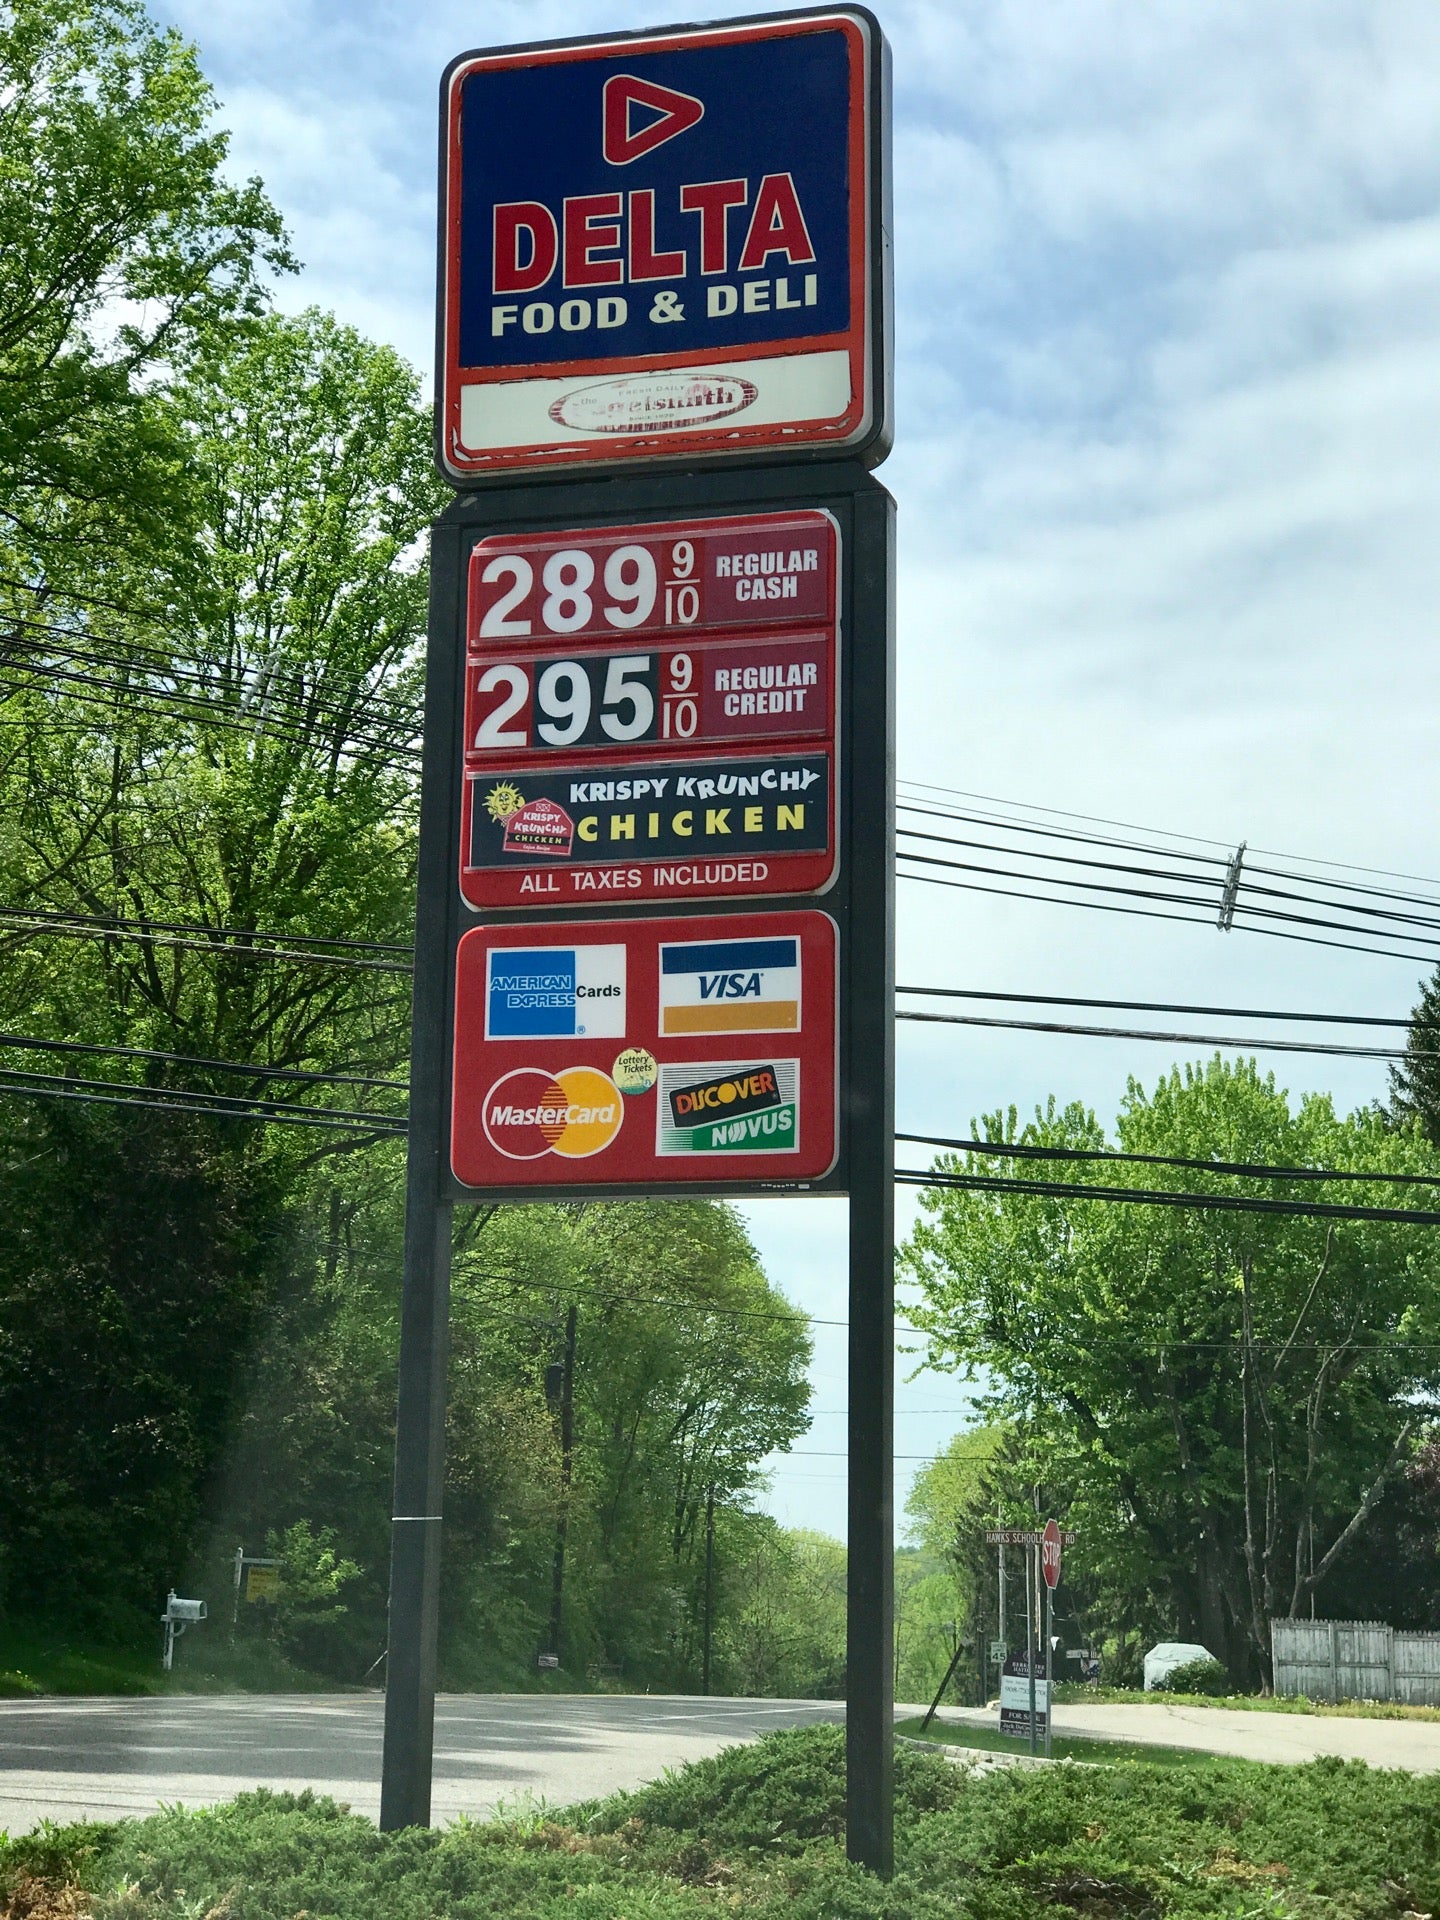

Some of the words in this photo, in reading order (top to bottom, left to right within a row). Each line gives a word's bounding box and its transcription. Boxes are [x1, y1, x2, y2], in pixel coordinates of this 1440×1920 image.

[492, 172, 817, 295] DELTA
[491, 296, 628, 337] FOOD
[649, 290, 687, 324] &
[707, 274, 818, 318] DELI
[716, 549, 818, 578] REGULAR
[479, 545, 657, 638] 289
[672, 540, 695, 578] 9
[735, 576, 798, 602] CASH
[665, 585, 700, 625] 10
[714, 663, 818, 692] REGULAR
[474, 655, 654, 749] 295
[670, 653, 693, 692] 9
[724, 688, 808, 717] CREDIT
[662, 699, 698, 739] 10
[569, 778, 669, 803] KRISPY
[676, 768, 820, 799] KRUNCHY
[514, 822, 567, 834] KRUNCHY
[523, 812, 561, 822] KRISPY
[577, 804, 806, 842] CHICKEN
[515, 834, 562, 844] CHICKEN
[519, 874, 560, 894] ALL
[570, 869, 642, 891] TAXES
[653, 862, 769, 887] INCLUDED
[490, 975, 571, 991] AMERICAN
[576, 985, 621, 998] Cards
[698, 973, 762, 999] VISA
[507, 993, 577, 1008] EXPRESS
[618, 1056, 649, 1065] Lottery
[623, 1064, 652, 1073] Tickets
[675, 1072, 776, 1115] DISCOVER
[490, 1104, 616, 1126] MasterCard
[712, 1109, 792, 1147] NOVUS
[986, 1532, 1010, 1543] HAWKS
[1065, 1534, 1075, 1544] RD
[1043, 1540, 1060, 1566] STOP
[992, 1652, 1006, 1661] 45
